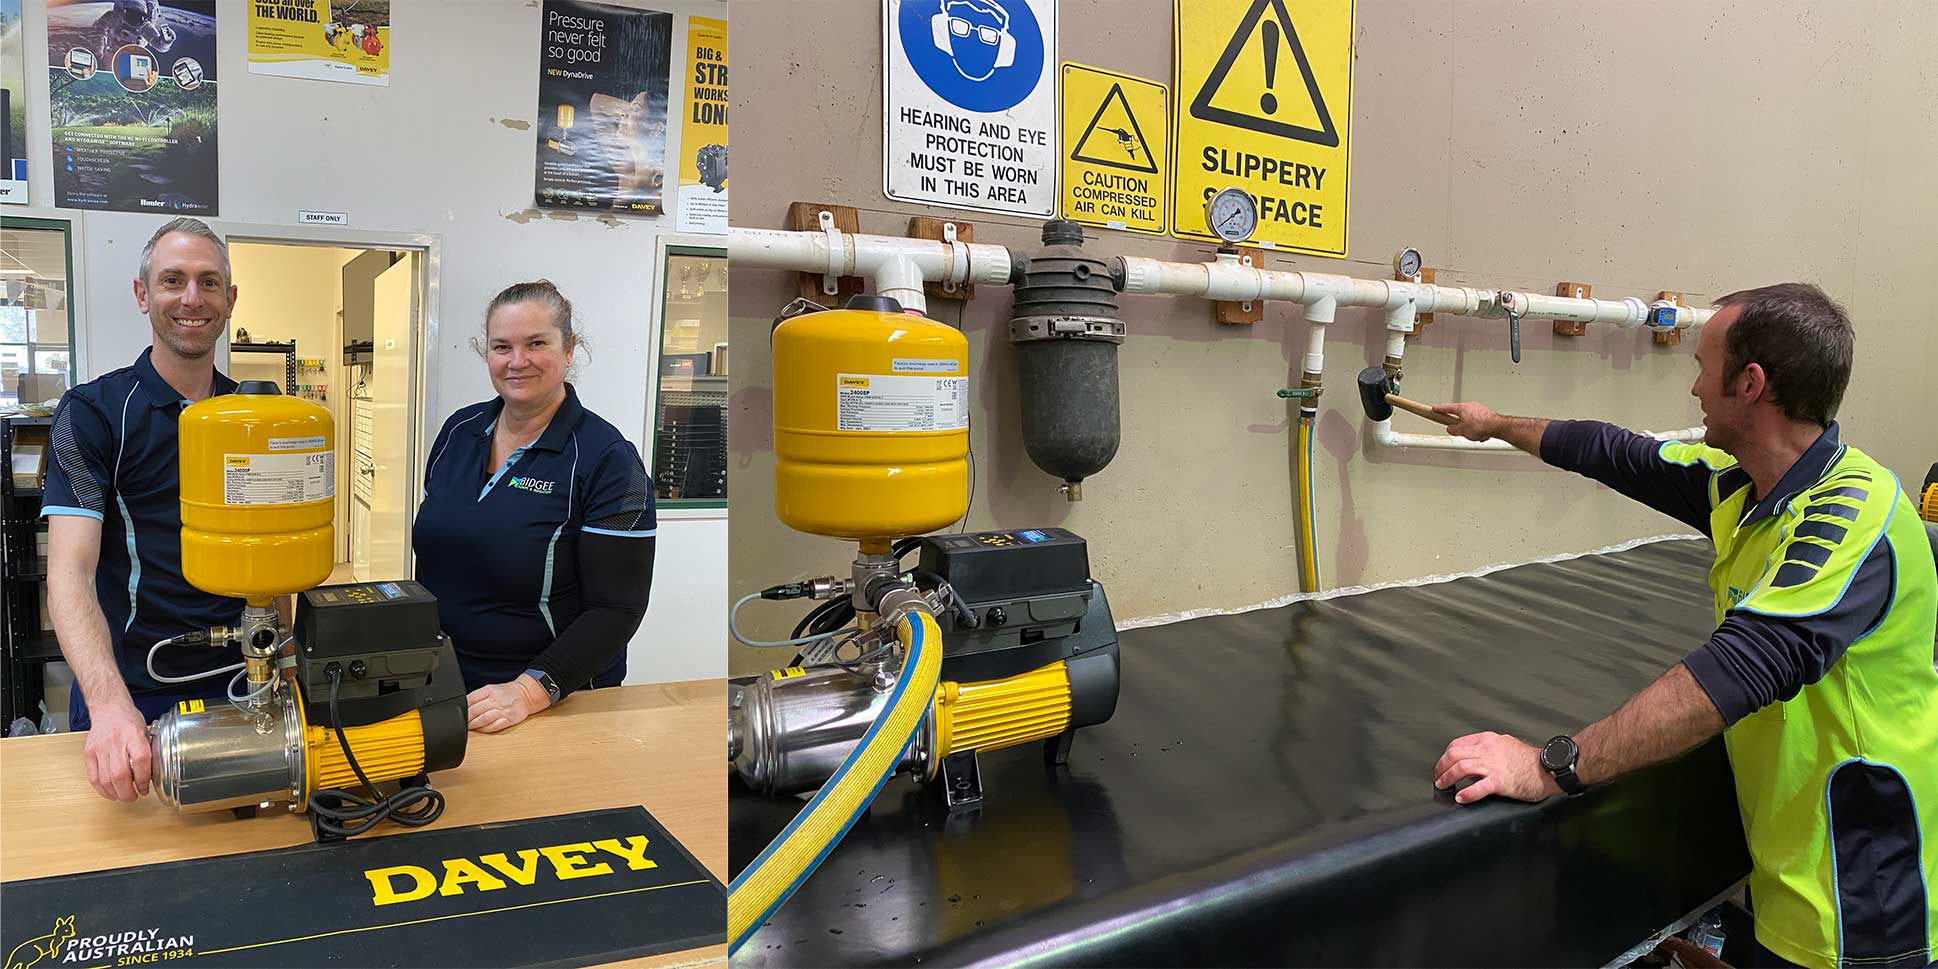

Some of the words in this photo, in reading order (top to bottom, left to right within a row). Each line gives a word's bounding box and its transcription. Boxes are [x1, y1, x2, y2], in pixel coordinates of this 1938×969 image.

[255, 5, 275, 18] THE
[276, 6, 320, 23] WORLD.
[549, 10, 604, 32] Pressure
[548, 30, 585, 45] never
[587, 31, 607, 48] felt
[548, 46, 564, 59] so
[567, 48, 601, 64] good
[696, 47, 713, 60] BIG
[715, 51, 723, 61] &
[547, 68, 562, 76] NEW
[563, 70, 594, 80] DynaDrive
[693, 102, 728, 125] LON
[900, 106, 971, 135] HEARING
[979, 122, 1011, 140] AND
[1018, 128, 1046, 146] EYE
[926, 133, 1024, 163] PROTECTION
[910, 152, 956, 174] MUST
[964, 161, 984, 178] BE
[992, 164, 1038, 185] WORN
[1201, 147, 1327, 191] SLIPPERY
[921, 176, 936, 192] IN
[944, 179, 979, 198] THIS
[987, 186, 1027, 204] AREA
[1083, 171, 1148, 194] CAUTION
[140, 199, 166, 207] Hunter
[631, 203, 656, 211] DAVEY
[1073, 186, 1157, 208] COMPRESSED
[1202, 187, 1323, 228] SFACE
[1074, 201, 1095, 213] AIR
[1101, 203, 1125, 217] CAN
[1131, 208, 1155, 221] KILL
[520, 477, 555, 491] BIDGEE
[364, 834, 659, 907] DAVEY
[62, 935, 194, 964] AUSTRALIAN
[66, 928, 160, 951] PROUDLY
[117, 952, 159, 967] SINCE
[162, 948, 193, 960] 1934
